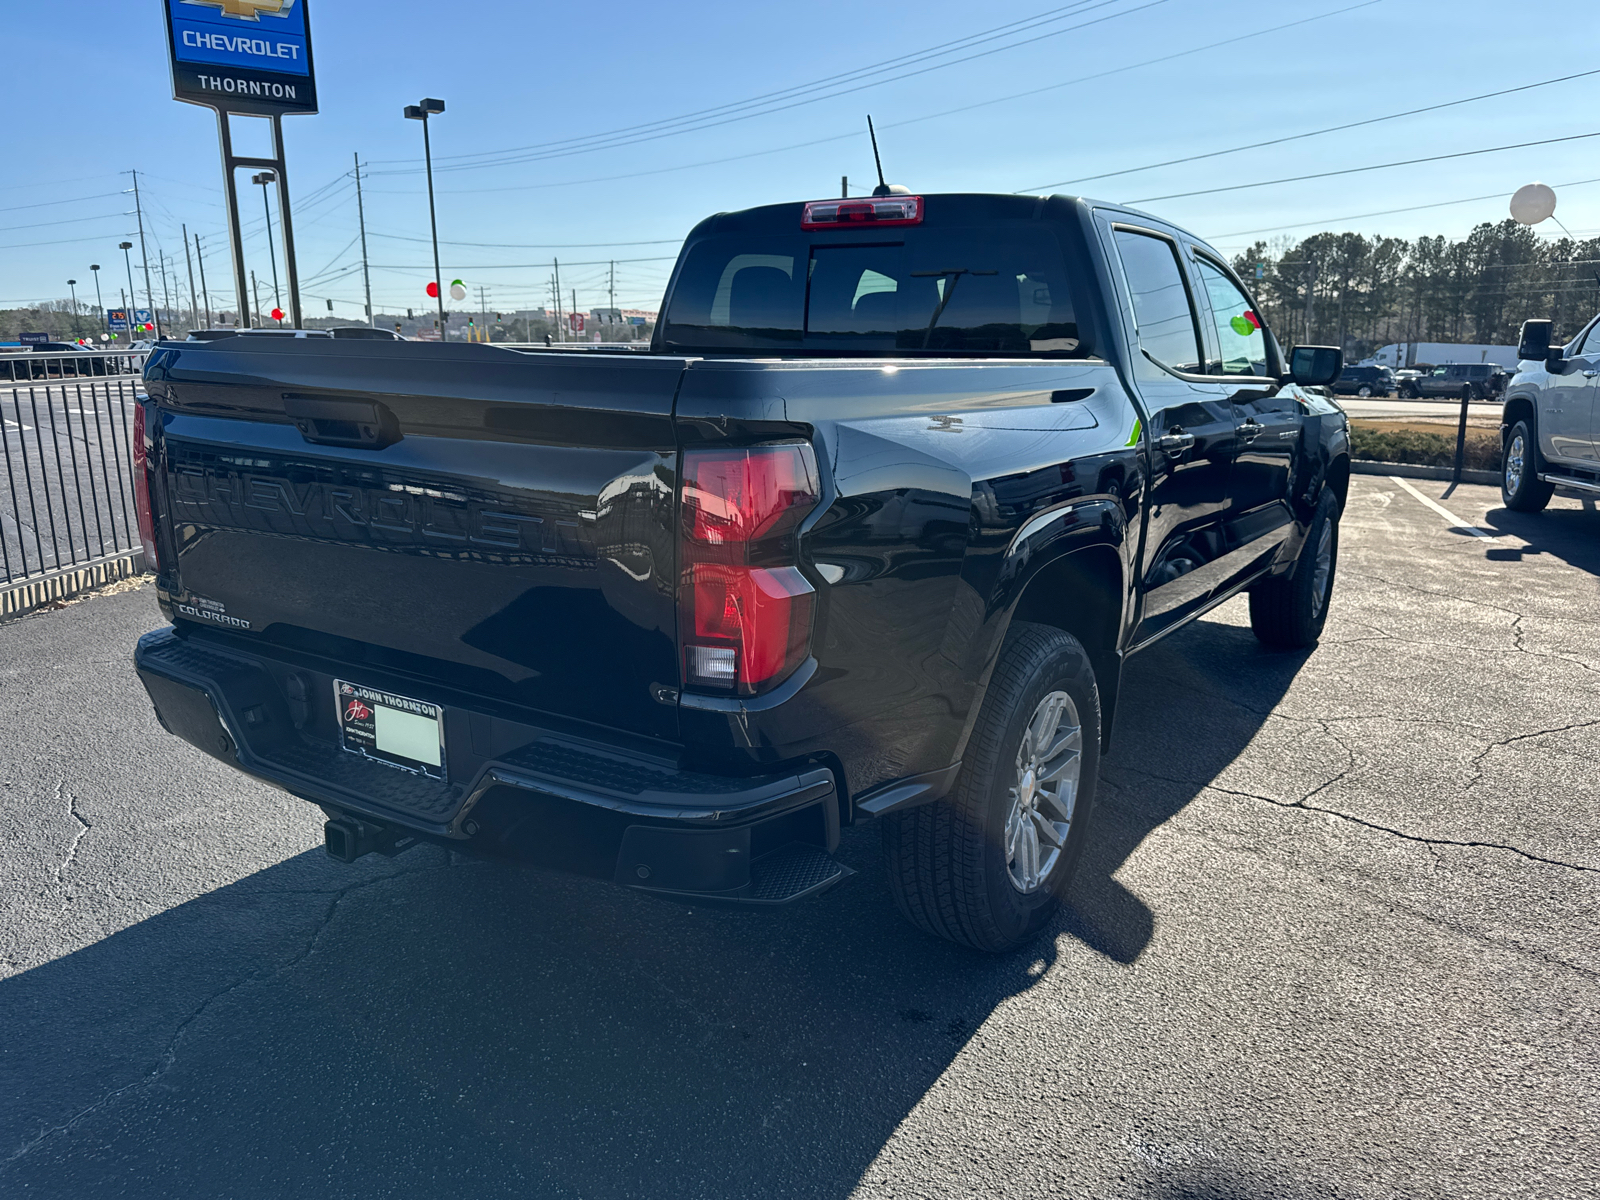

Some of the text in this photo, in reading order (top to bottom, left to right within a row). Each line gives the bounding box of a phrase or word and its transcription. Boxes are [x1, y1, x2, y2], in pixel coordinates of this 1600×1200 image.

[182, 30, 300, 60] CHEVROLET
[197, 75, 297, 99] THORNTON
[174, 464, 581, 554] CHEVROLET
[178, 604, 251, 629] COLORADO
[358, 687, 382, 702] JOHN
[383, 695, 436, 717] THORNTON
